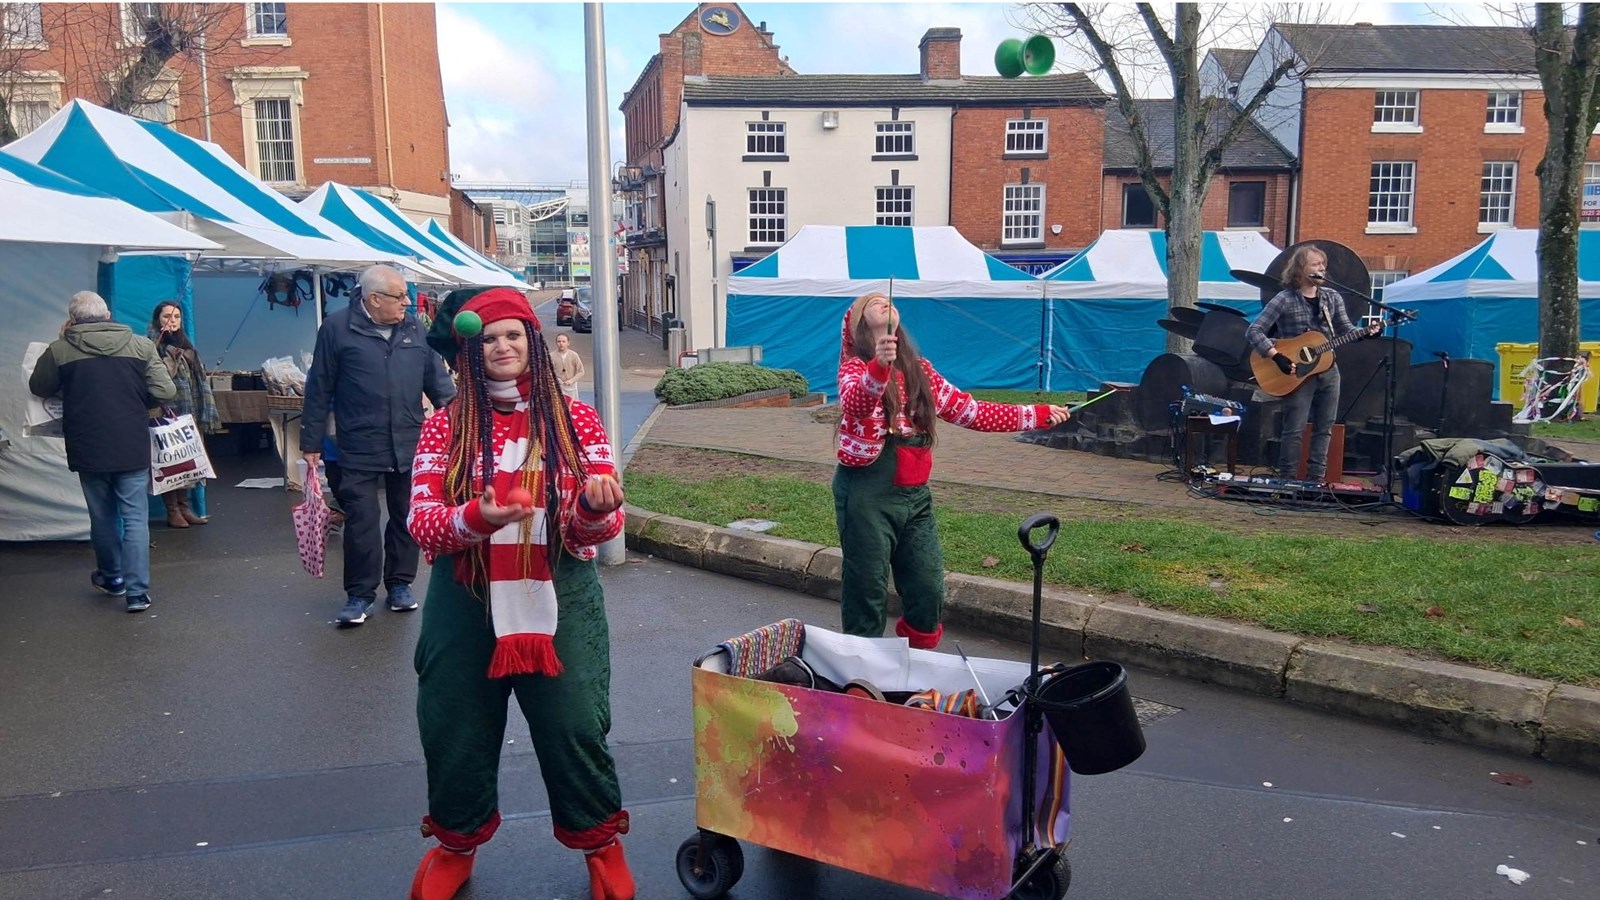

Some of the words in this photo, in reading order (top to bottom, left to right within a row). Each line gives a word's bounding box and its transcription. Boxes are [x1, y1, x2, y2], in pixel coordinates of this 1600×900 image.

[155, 425, 193, 450] WINE
[157, 442, 202, 464] LOADING
[166, 473, 190, 484] PLEASE
